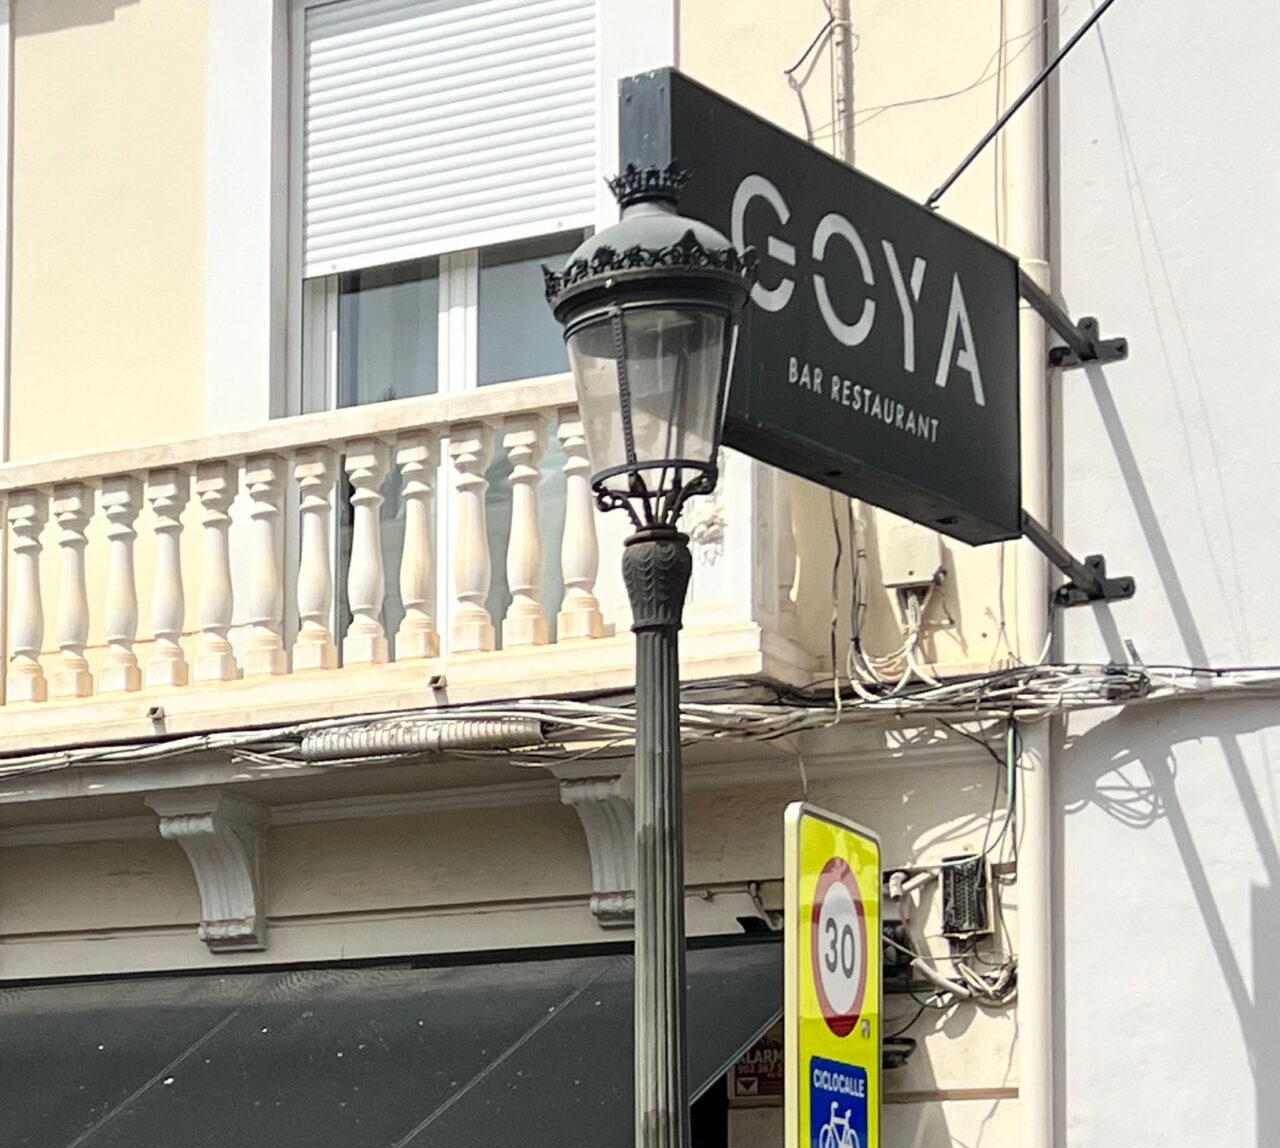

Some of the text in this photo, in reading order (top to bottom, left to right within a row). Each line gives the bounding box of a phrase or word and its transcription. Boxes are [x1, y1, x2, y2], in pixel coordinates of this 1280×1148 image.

[730, 173, 987, 406] GOYA
[788, 356, 940, 444] BAR RESTAURANT
[825, 917, 855, 979] 30
[813, 1068, 865, 1098] CICLOCALLE
